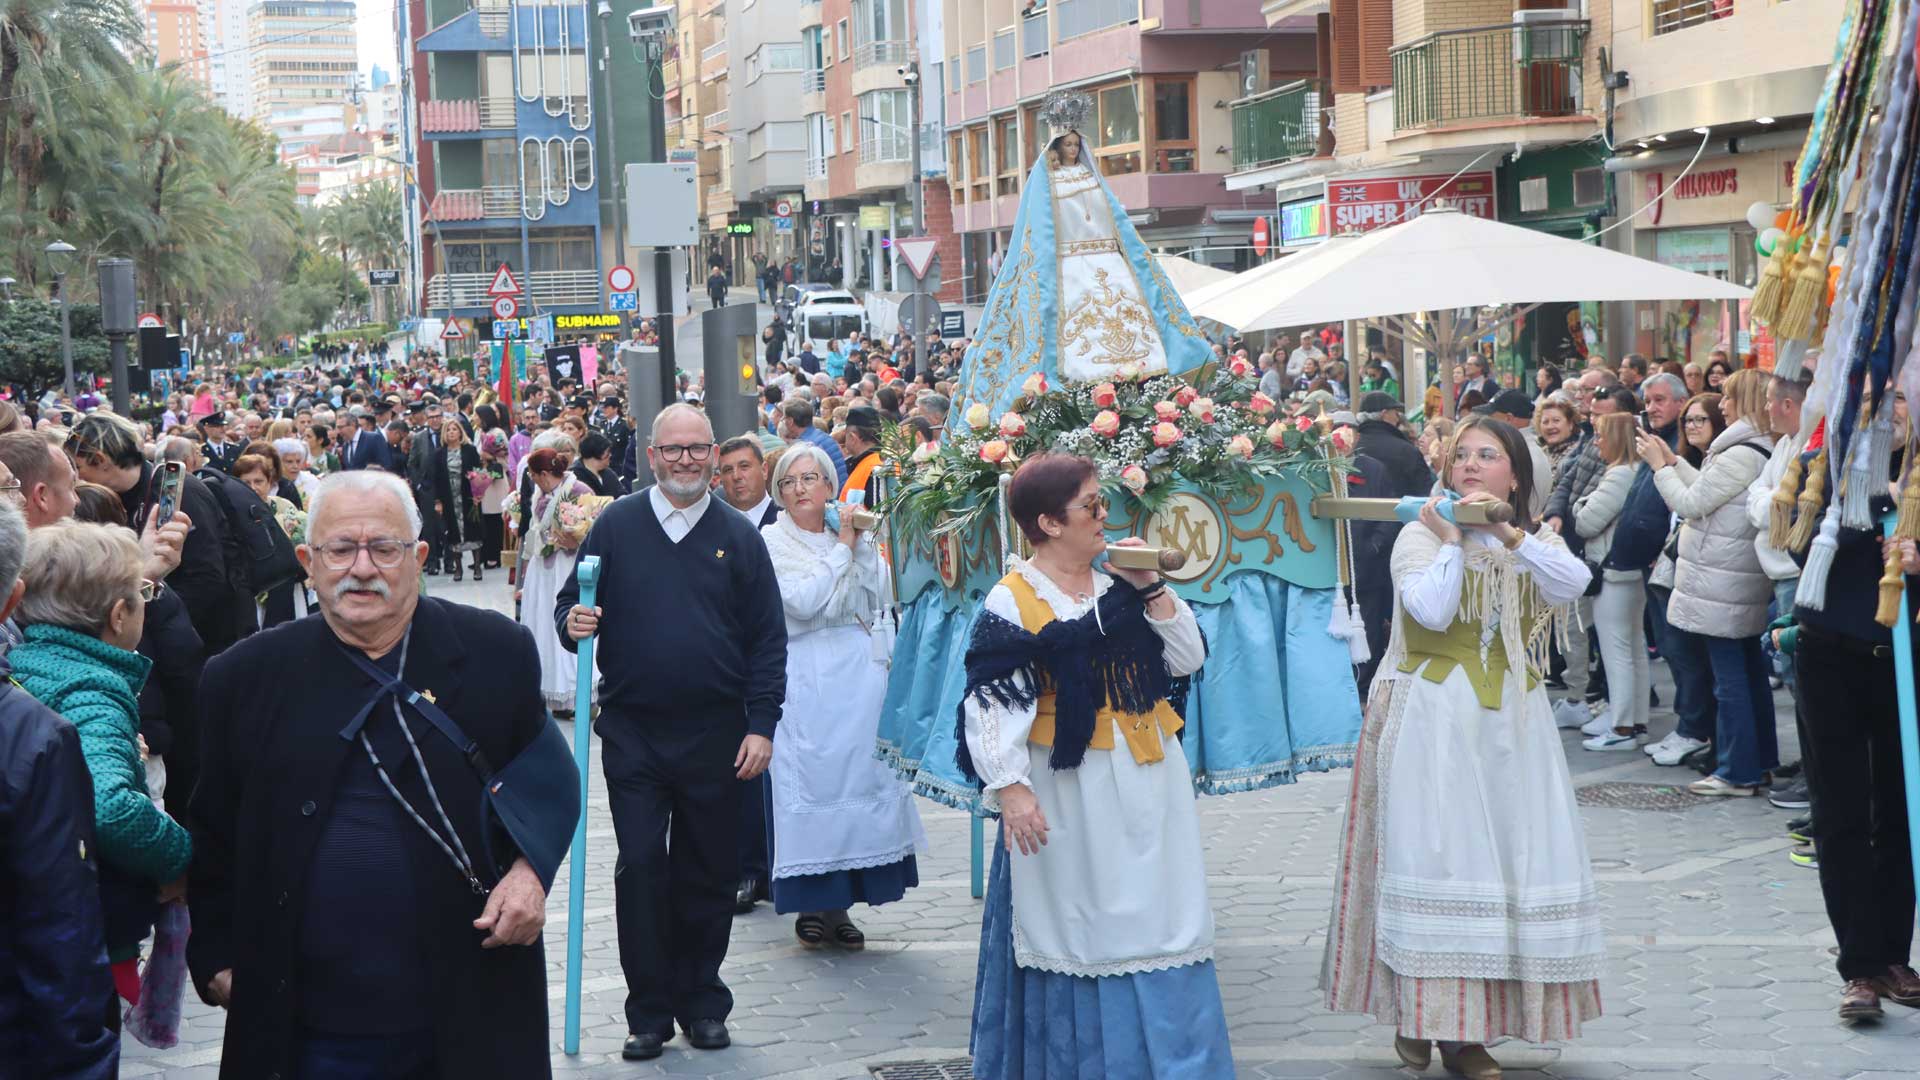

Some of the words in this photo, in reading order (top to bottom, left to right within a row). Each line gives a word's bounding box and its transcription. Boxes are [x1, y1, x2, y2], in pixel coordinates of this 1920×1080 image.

[1398, 181, 1423, 199] UK
[1336, 203, 1398, 226] SUPER
[500, 303, 511, 312] 10
